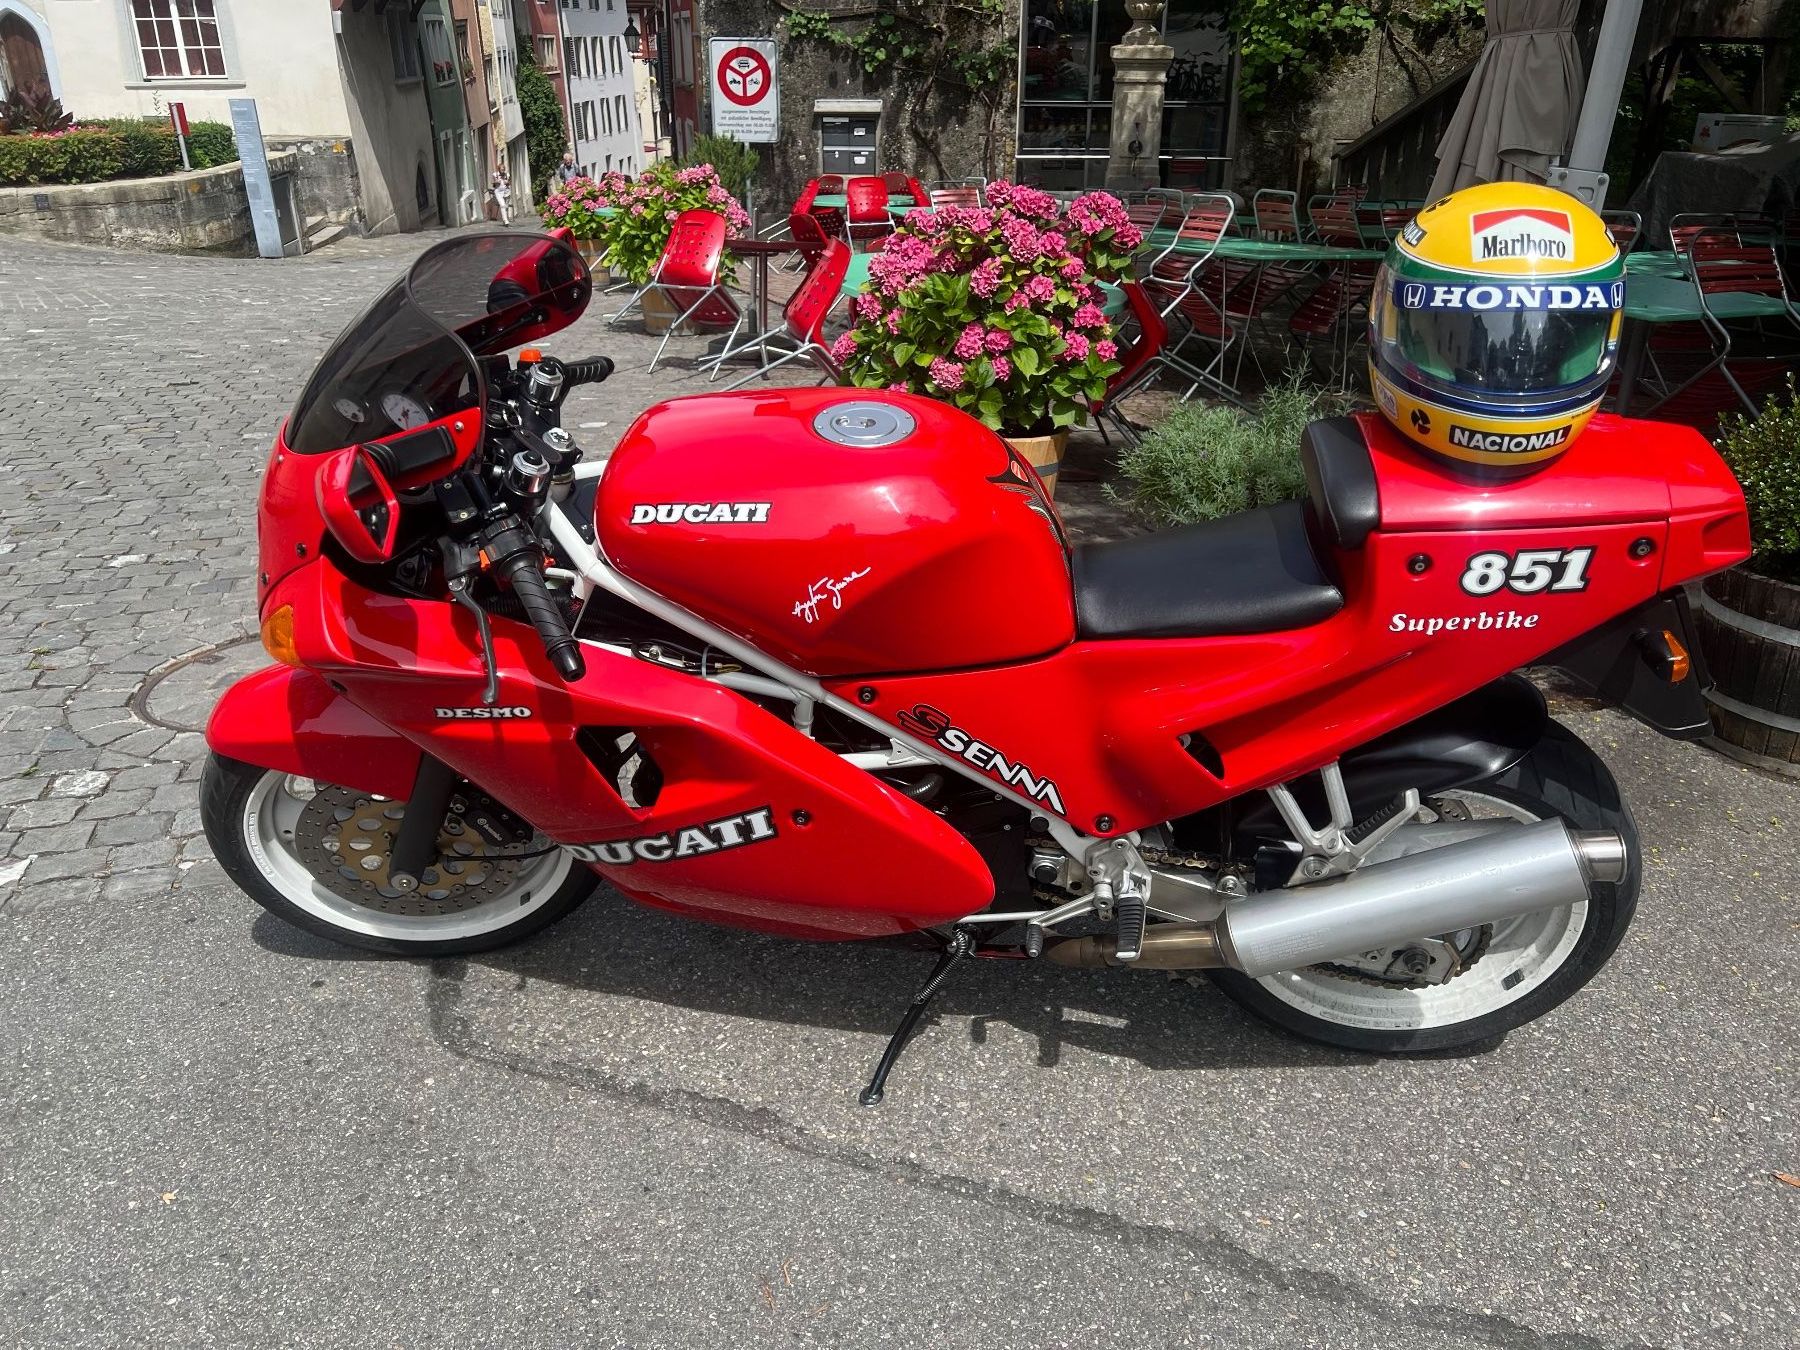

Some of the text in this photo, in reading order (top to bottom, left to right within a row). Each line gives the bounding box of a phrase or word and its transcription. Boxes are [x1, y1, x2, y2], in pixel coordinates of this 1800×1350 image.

[1482, 233, 1566, 258] Marlboro
[1430, 285, 1609, 309] HONDA
[1453, 428, 1566, 452] NACIONAL
[630, 502, 772, 525] DUCATI
[1460, 547, 1594, 596] 851
[1389, 611, 1539, 635] Superbike
[434, 706, 533, 718] DESMO
[937, 727, 1067, 816] SENNA
[559, 807, 776, 864] DUCATI
